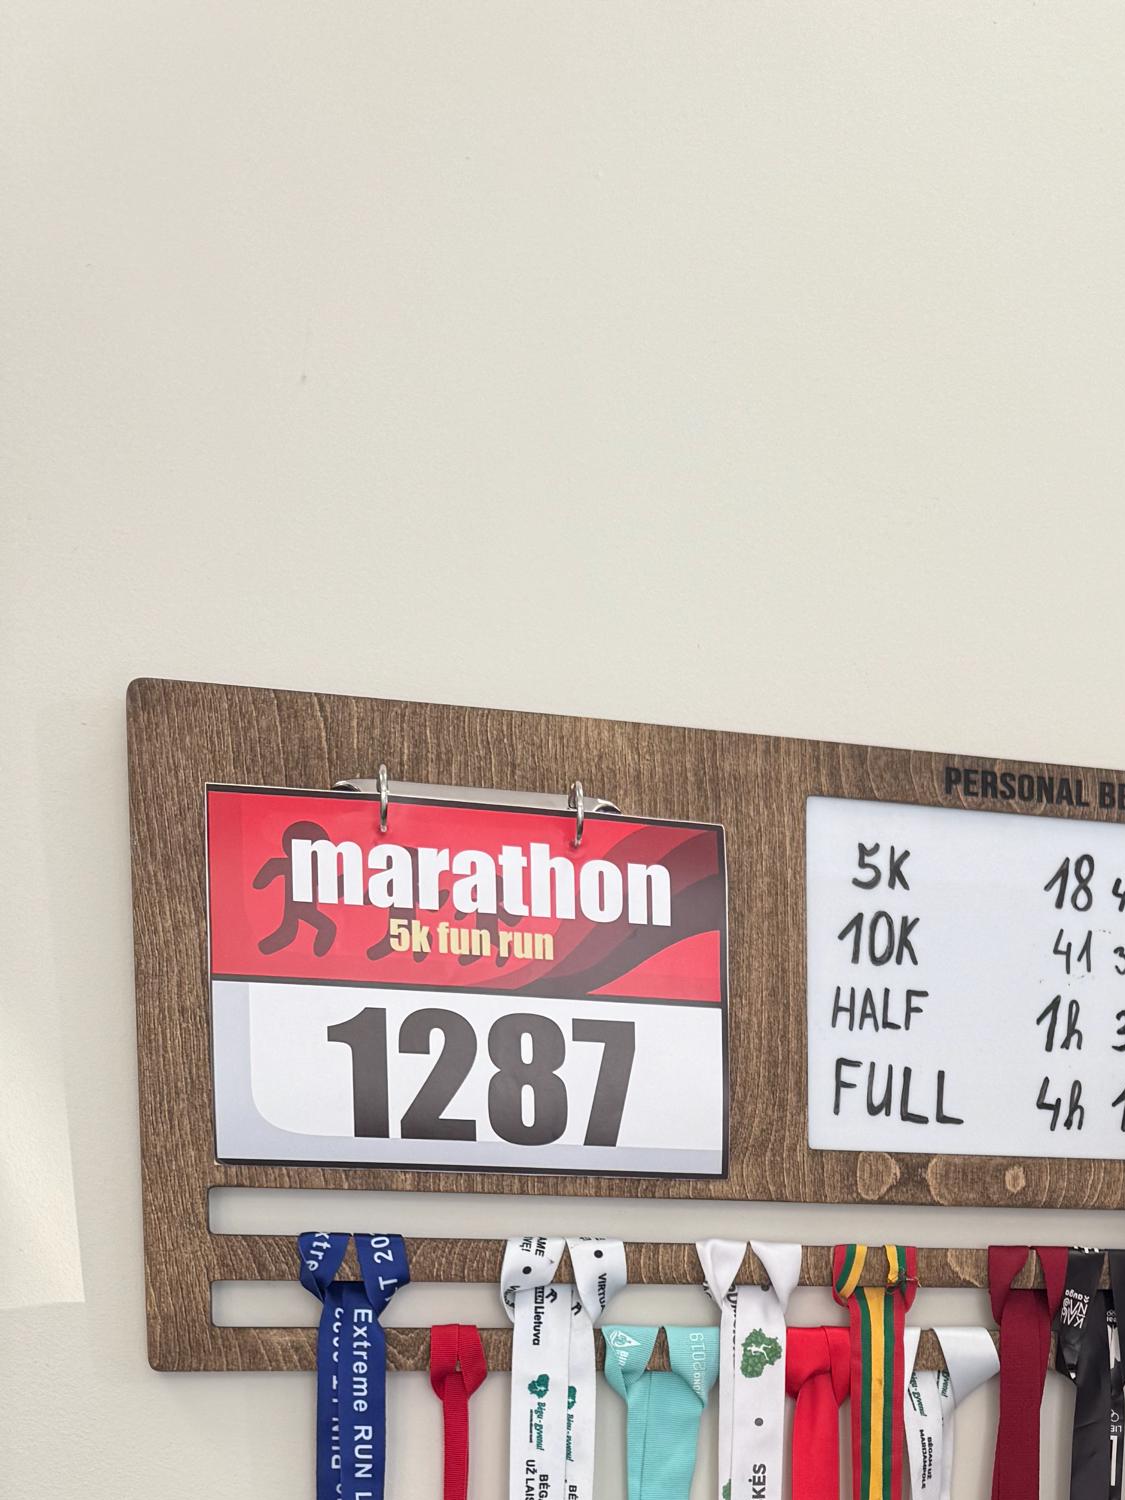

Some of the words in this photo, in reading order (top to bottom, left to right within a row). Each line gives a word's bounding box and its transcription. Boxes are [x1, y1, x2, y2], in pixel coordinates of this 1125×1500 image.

[944, 766, 1090, 808] PERSONAL
[291, 838, 671, 927] marathon
[851, 842, 911, 891] 5K
[1043, 854, 1095, 912] 18
[389, 918, 432, 953] 5k
[437, 922, 492, 957] fun
[498, 929, 554, 961] run
[837, 910, 920, 966] 10K
[1052, 928, 1093, 974] 41
[831, 986, 929, 1031] HALF
[1036, 995, 1083, 1052] 1h
[326, 1006, 636, 1148] 1287
[833, 1057, 964, 1125] FULL
[1036, 1077, 1084, 1131] 4h
[532, 1305, 545, 1346] Lietuva
[352, 1308, 373, 1413] Extreme
[353, 1425, 373, 1478] RUN
[525, 1459, 538, 1475] UŽ
